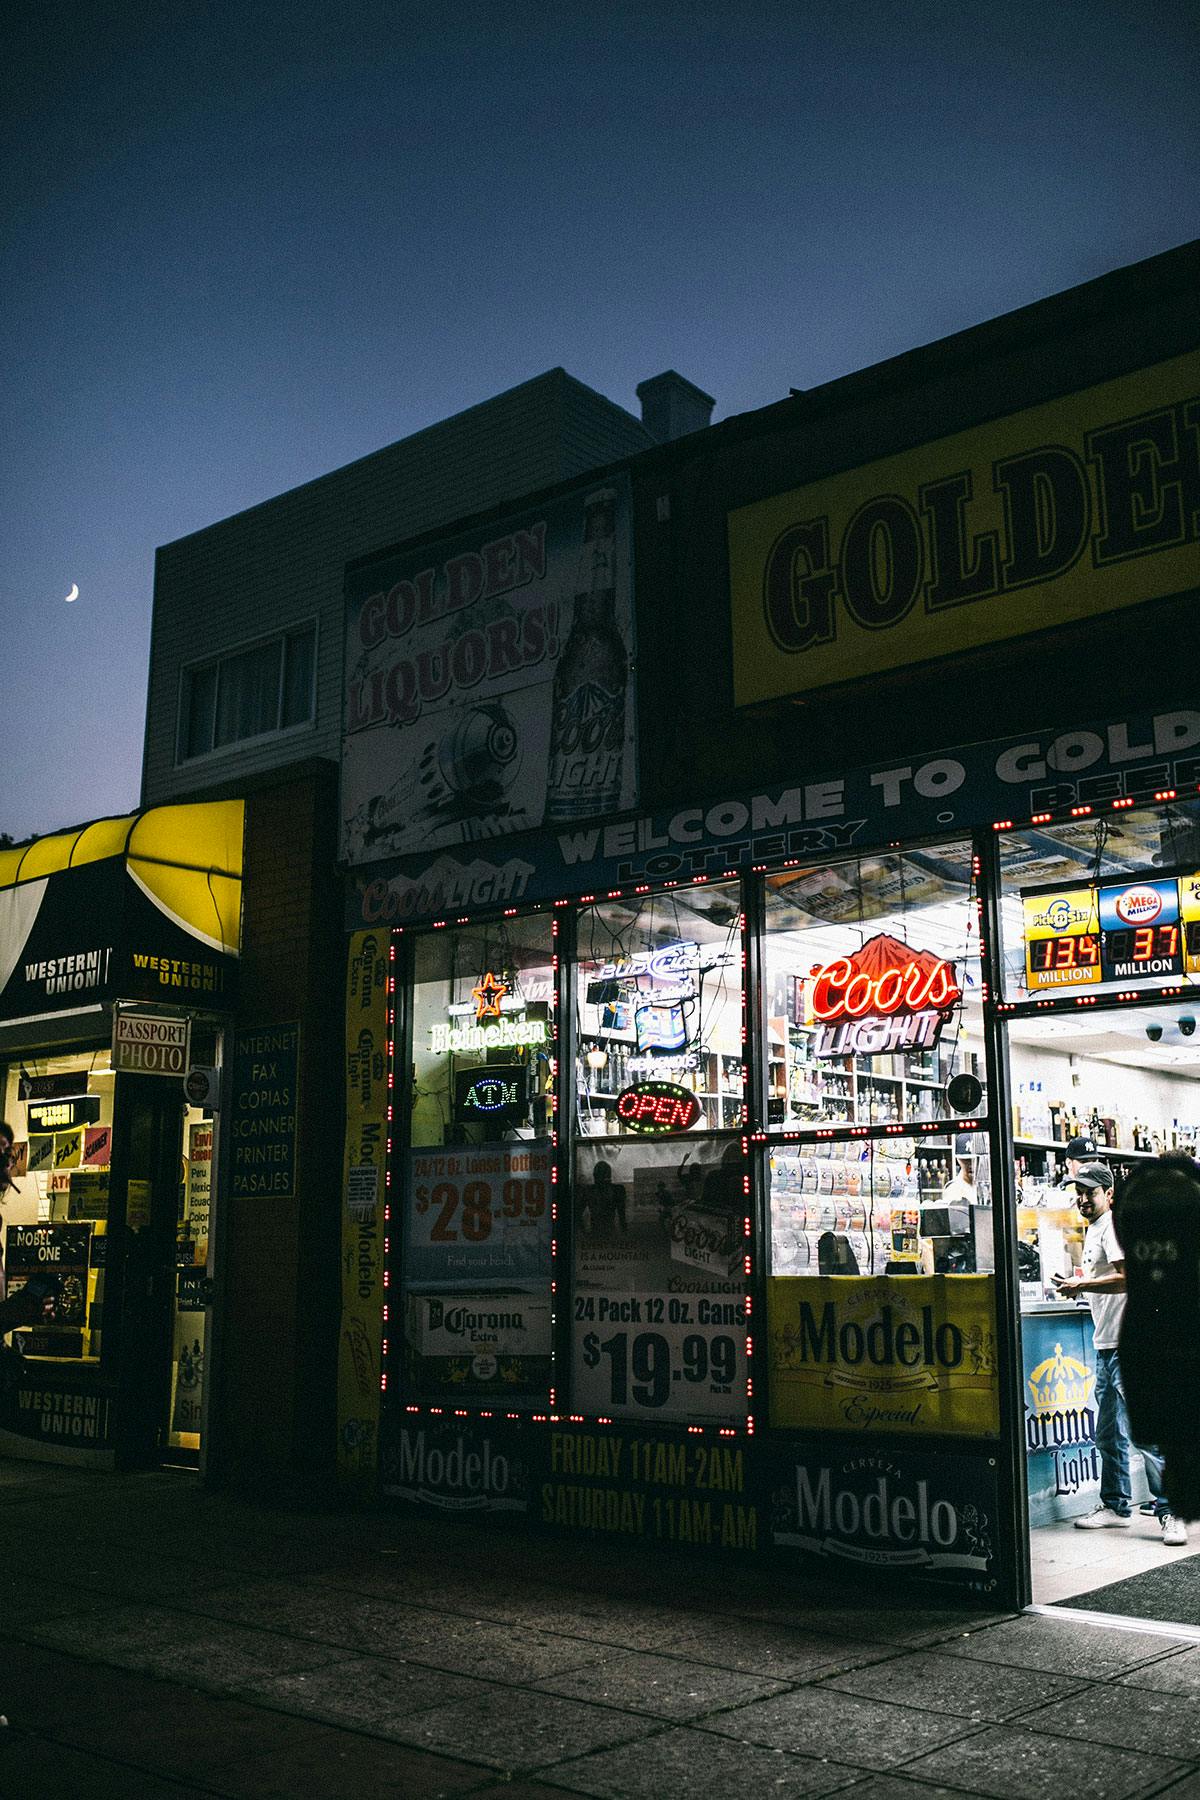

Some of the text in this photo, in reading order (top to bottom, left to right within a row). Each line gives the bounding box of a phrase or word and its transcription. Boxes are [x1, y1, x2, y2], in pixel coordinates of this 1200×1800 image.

[360, 521, 547, 652] GOLDEN
[557, 779, 845, 865] WELCOME
[870, 757, 967, 807] TO
[617, 818, 868, 885] LOTTERY
[361, 868, 535, 922] Coors LIGHT
[1128, 896, 1158, 909] MEGA
[1133, 925, 1179, 961] 37
[25, 950, 97, 982] WESTERN
[133, 953, 214, 978] WESTERN
[360, 935, 378, 1010] Corona
[1037, 967, 1094, 984] MILLION
[1114, 958, 1174, 977] MILLION
[46, 969, 97, 995] UNION
[159, 973, 214, 991] UNION
[809, 957, 962, 1020] Coors
[118, 1020, 185, 1043] PASSPORT
[234, 1031, 297, 1056] INTERNET
[431, 1016, 546, 1051] Heineken
[813, 1010, 941, 1060] LIGHT
[118, 1043, 184, 1071] PHOTO
[357, 1027, 374, 1104] Corona
[251, 1063, 277, 1081] FAX
[238, 1088, 290, 1110] COPIAS
[463, 1082, 518, 1106] ATM
[618, 1092, 693, 1126] OPEN
[232, 1115, 295, 1138] SCANNER
[56, 1135, 79, 1167] FAX
[236, 1144, 289, 1164] PRINTER
[503, 1151, 548, 1172] Bottles
[191, 1168, 206, 1178] Peru
[233, 1171, 290, 1192] PASAJES
[415, 1178, 546, 1242] $28.99
[17, 1230, 51, 1247] NOBEL
[38, 1246, 61, 1262] ONE
[357, 1221, 377, 1299] Modelo
[684, 1246, 711, 1264] LIGHT
[710, 1281, 748, 1294] LIGHT
[443, 1306, 525, 1337] Corona
[575, 1297, 747, 1326] 24 Pack 12 Oz. Cans
[470, 1329, 499, 1342] Extra
[798, 1300, 963, 1368] Modelo
[582, 1331, 737, 1408] $19.99
[19, 1390, 96, 1416] WESTERN
[40, 1414, 96, 1438] UNION
[1024, 1404, 1098, 1452] orona
[399, 1428, 508, 1492] Modelo
[551, 1432, 745, 1493] FRIDAY 11AM-2AM
[1050, 1448, 1100, 1497] Light
[542, 1483, 645, 1537] SATURDAY
[796, 1464, 959, 1546] Modelo
